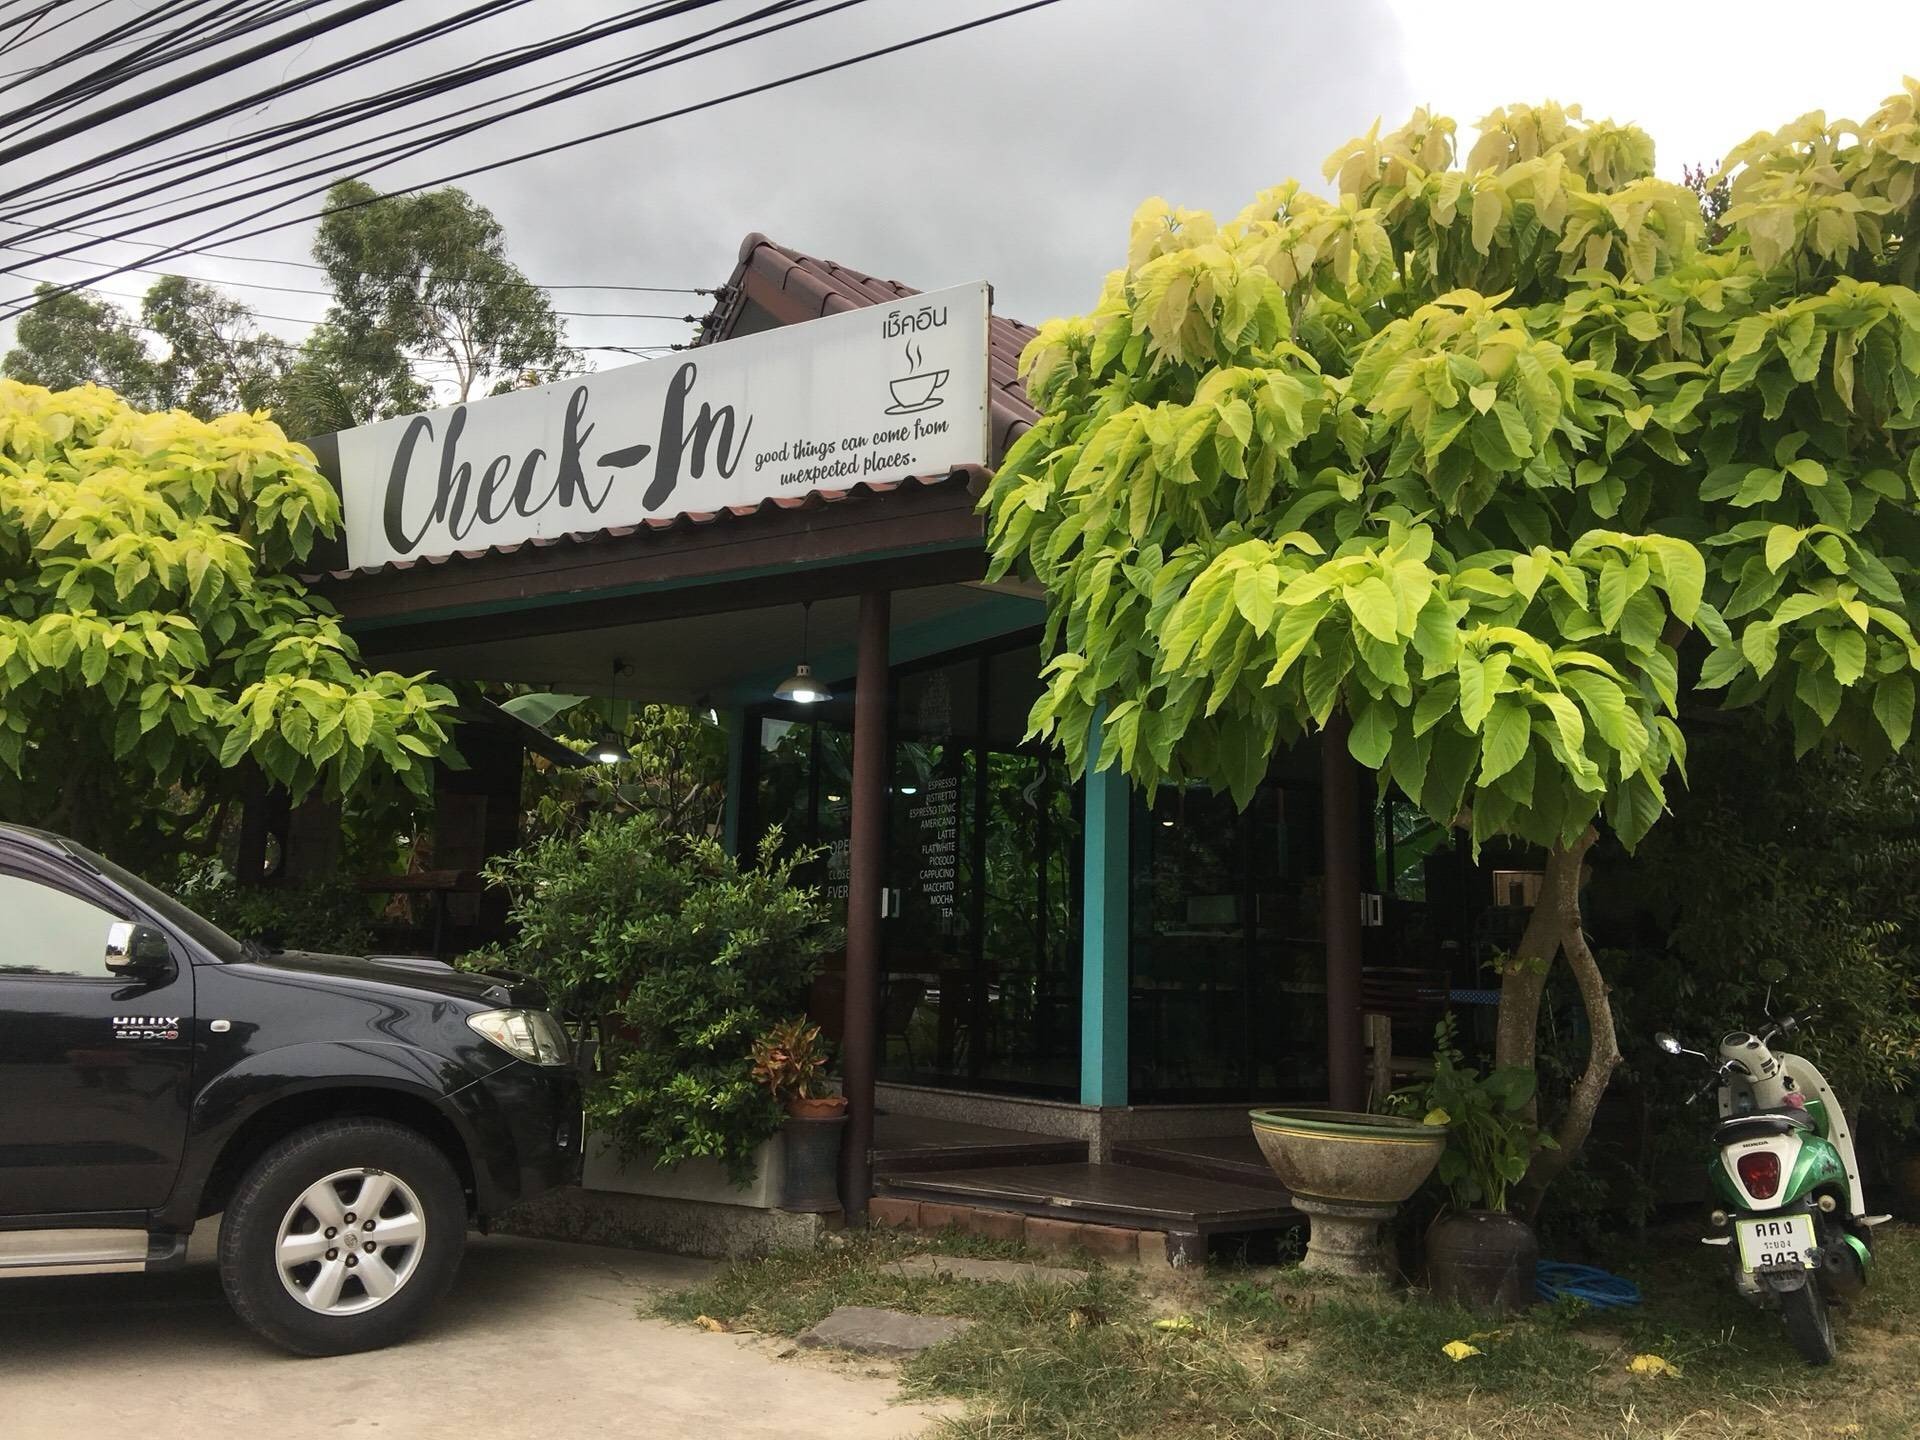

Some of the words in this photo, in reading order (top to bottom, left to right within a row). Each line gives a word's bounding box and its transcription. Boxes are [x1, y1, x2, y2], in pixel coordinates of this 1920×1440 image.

[883, 306, 947, 339] เช็คอิน
[755, 442, 790, 471] good
[793, 439, 836, 461] things
[841, 437, 869, 451] can
[873, 426, 910, 443] come
[914, 418, 949, 440] from
[384, 362, 753, 554] Check-In
[780, 454, 860, 485] unexpected
[863, 451, 917, 475] places.
[928, 776, 957, 790] ESPRESSO
[926, 790, 957, 803] RISTRETTO
[909, 806, 937, 819] ESPRESSO
[938, 802, 956, 815] TONIC
[920, 816, 956, 830] AMERICANO
[937, 829, 956, 840] LATTE
[830, 839, 851, 856] OPE
[929, 855, 955, 866] PICCOLO
[930, 894, 954, 905] MOCHA
[942, 907, 954, 918] TEA
[1743, 1140, 1769, 1148] HONDA
[1761, 1251, 1800, 1266] 943
